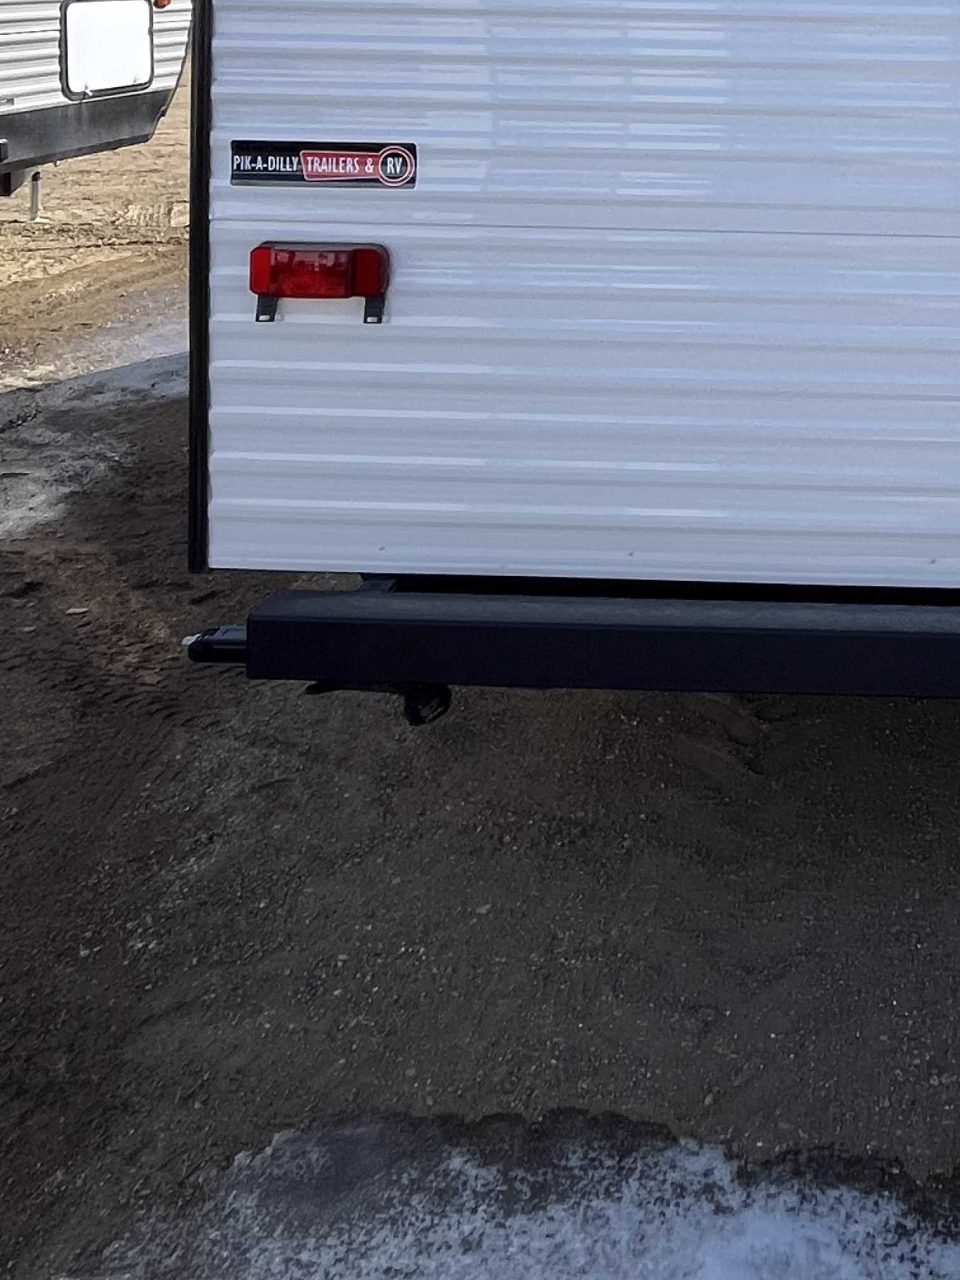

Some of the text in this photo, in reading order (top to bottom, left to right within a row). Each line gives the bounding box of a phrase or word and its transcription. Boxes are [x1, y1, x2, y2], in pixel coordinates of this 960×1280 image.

[233, 154, 402, 174] PIK-A-DILLY TRAILERS & RV
